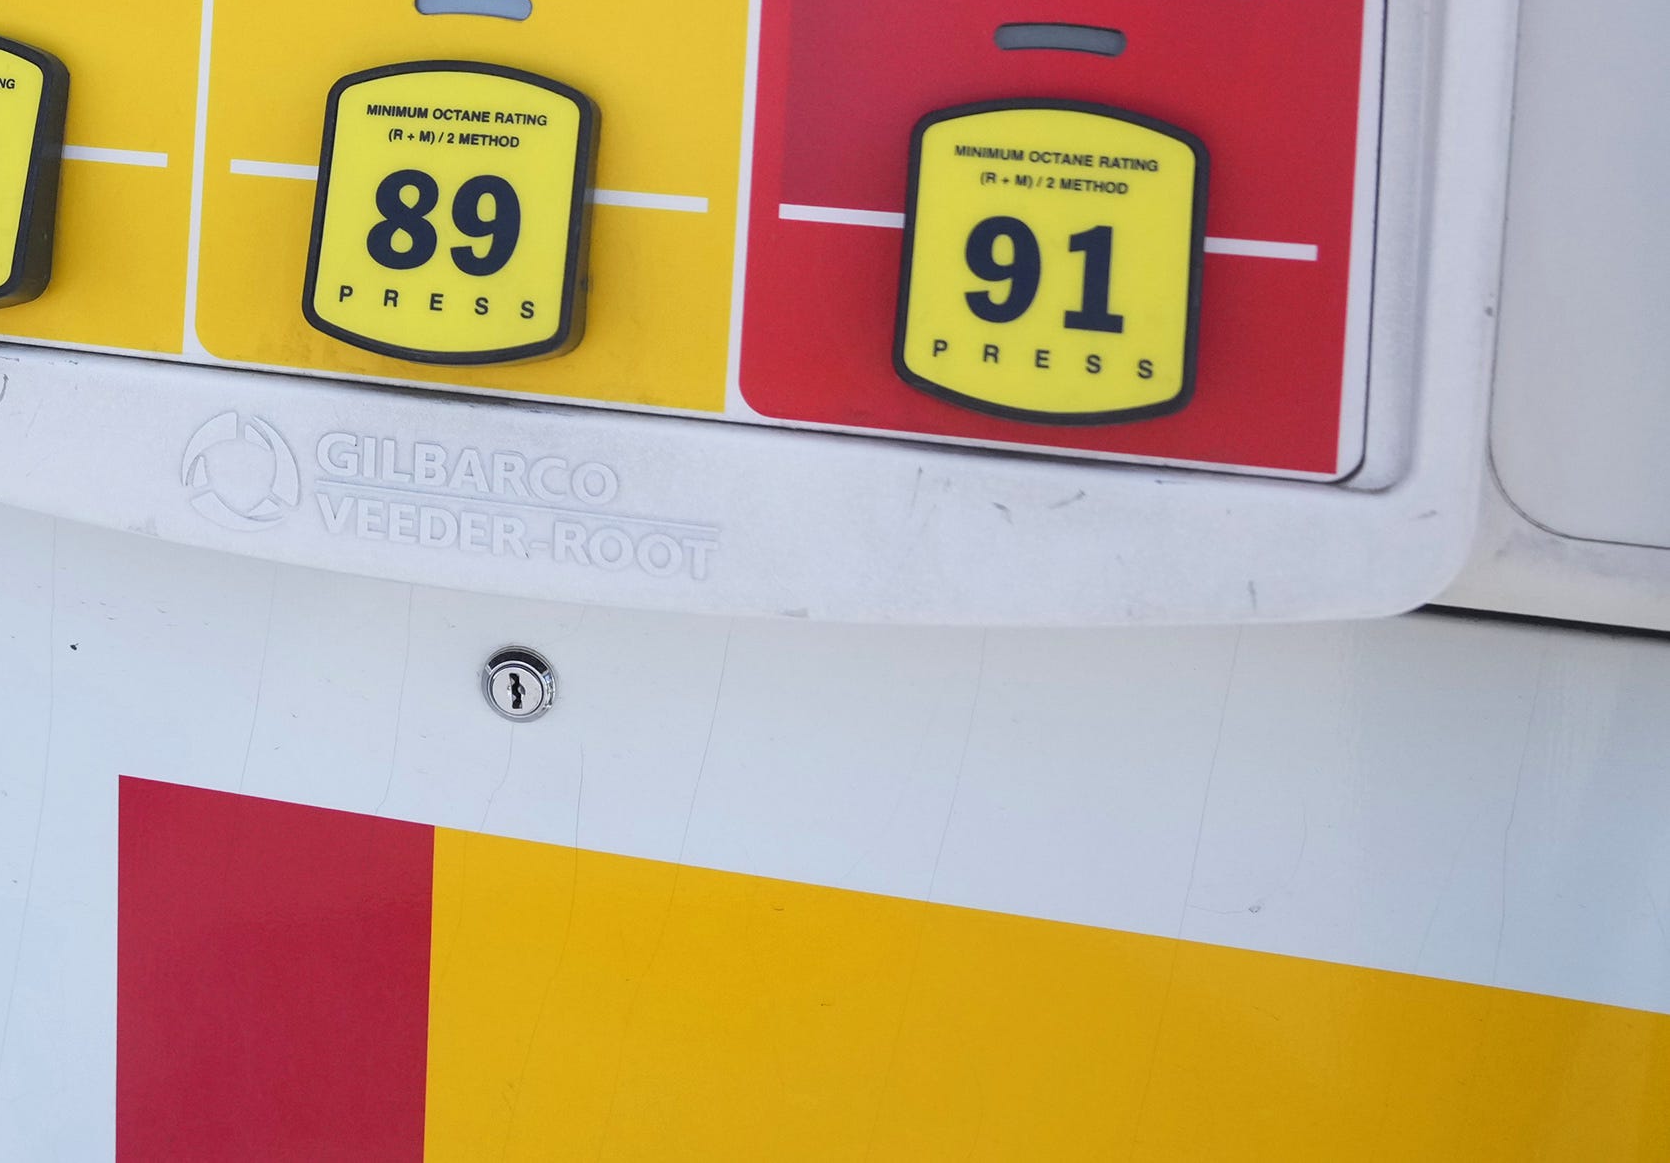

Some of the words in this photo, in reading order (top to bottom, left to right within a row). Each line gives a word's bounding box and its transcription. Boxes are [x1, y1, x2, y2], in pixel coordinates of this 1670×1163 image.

[366, 104, 429, 119] MINIMUM
[432, 108, 491, 123] OCTANE
[494, 111, 548, 127] RATING
[388, 129, 404, 142] (R
[407, 133, 415, 141] +
[419, 130, 435, 144] M)
[438, 131, 444, 144] /
[447, 132, 455, 145] 2
[458, 133, 520, 149] METHOD
[954, 145, 1024, 162] MINIMUM
[1029, 150, 1094, 167] OCTANE
[1098, 156, 1160, 173] RATING
[980, 172, 997, 186] (R
[1001, 177, 1010, 185] +
[1014, 174, 1033, 189] M)
[1046, 176, 1055, 189] 2
[1059, 178, 1129, 195] METHOD
[367, 169, 521, 277] 89
[963, 215, 1124, 334] 91
[316, 431, 619, 506] GILBARCO
[315, 492, 720, 581] VEEDER-ROOT
